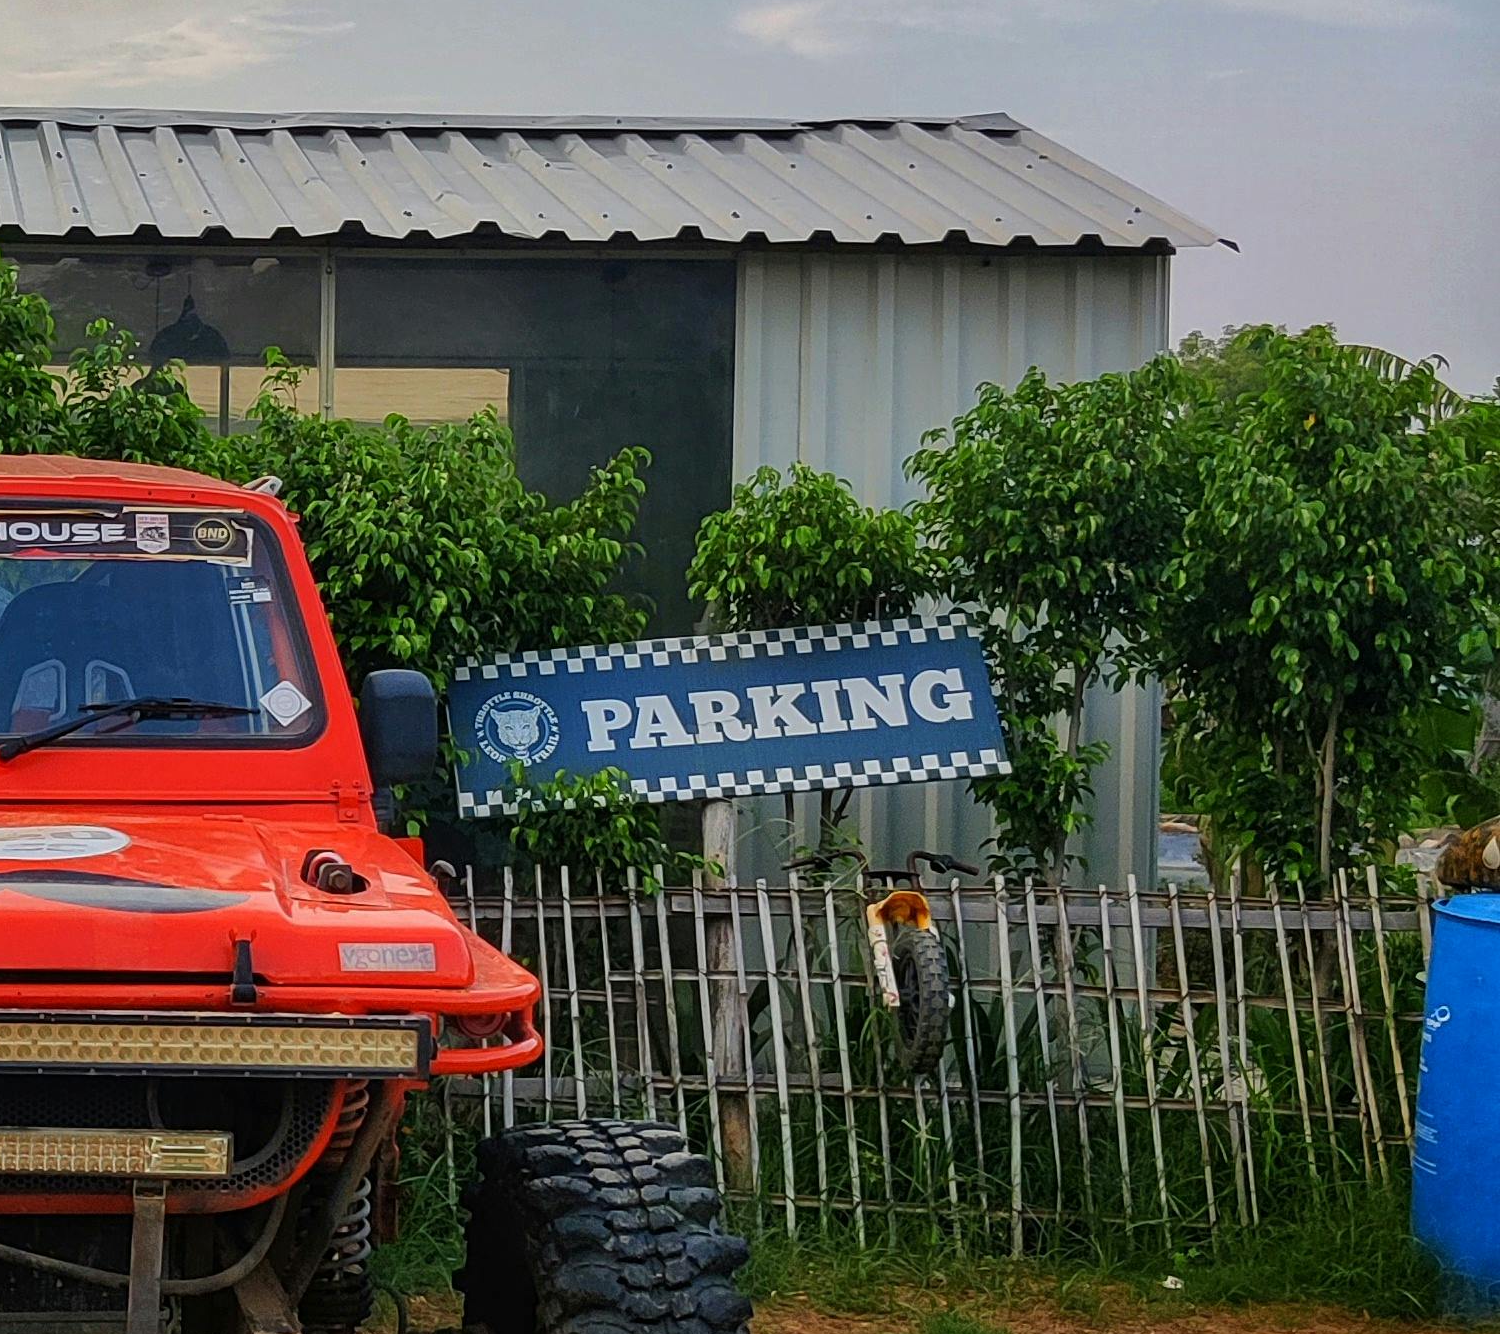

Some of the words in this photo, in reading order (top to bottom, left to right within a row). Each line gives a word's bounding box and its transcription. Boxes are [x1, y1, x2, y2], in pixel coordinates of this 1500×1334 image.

[197, 527, 228, 540] BND
[474, 691, 512, 729] THROTTLE
[513, 690, 559, 724] SHROTTLE
[581, 668, 973, 752] PARKING
[479, 740, 532, 767] LEOPD
[532, 734, 559, 763] TRAIL
